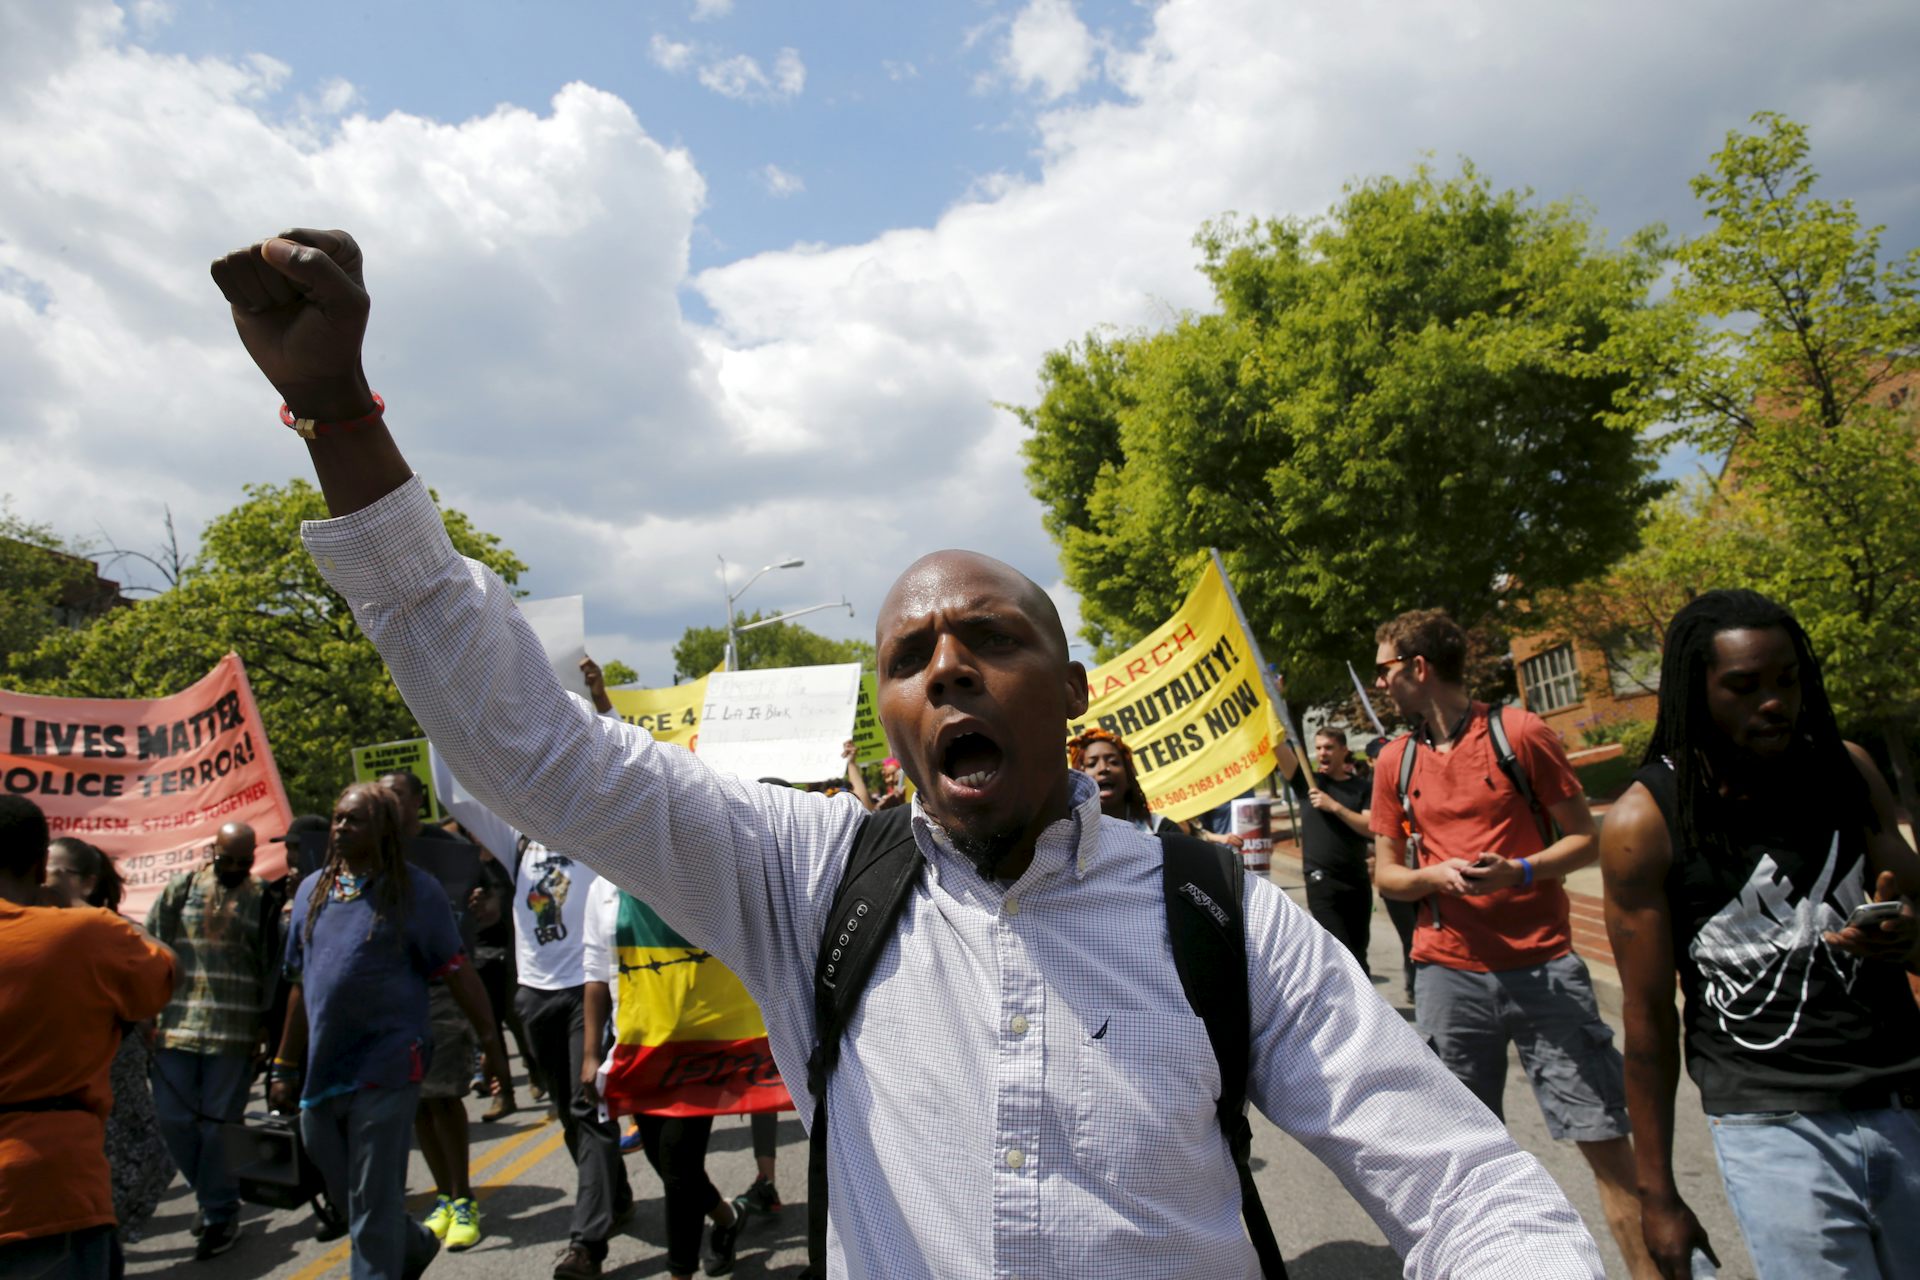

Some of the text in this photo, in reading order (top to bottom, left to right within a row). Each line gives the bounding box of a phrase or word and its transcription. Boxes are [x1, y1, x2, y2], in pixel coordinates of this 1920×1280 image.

[703, 703, 717, 721] I
[746, 706, 761, 721] It
[1097, 634, 1240, 737] BRUTALITY!
[10, 689, 245, 761] LIVES MATTER
[620, 707, 697, 732] ICE 4
[1132, 679, 1260, 777] TERS NOW
[0, 731, 255, 798] OLICE TERROR!
[201, 780, 268, 822] TOGETHER
[1179, 881, 1229, 928] JANSPORT
